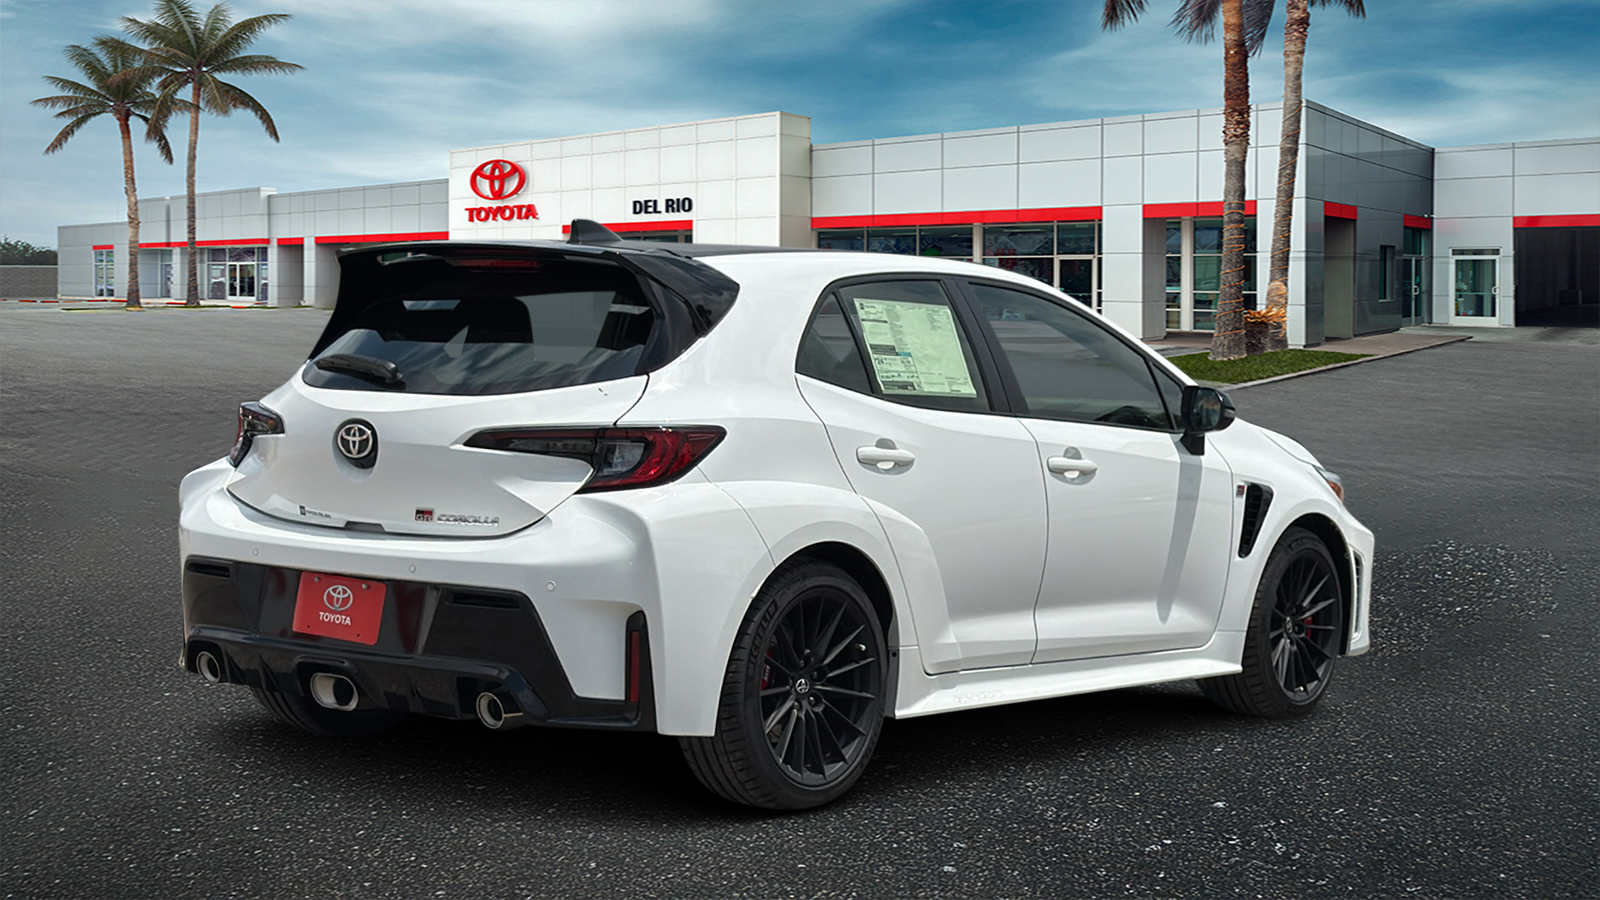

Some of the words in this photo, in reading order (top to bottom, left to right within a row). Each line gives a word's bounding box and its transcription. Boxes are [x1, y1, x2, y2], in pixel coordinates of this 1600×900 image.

[465, 204, 539, 222] TOYOTA
[632, 199, 661, 215] DEL
[665, 197, 693, 213] RIO
[437, 514, 499, 526] COROLLA
[319, 611, 351, 626] TOYOTA
